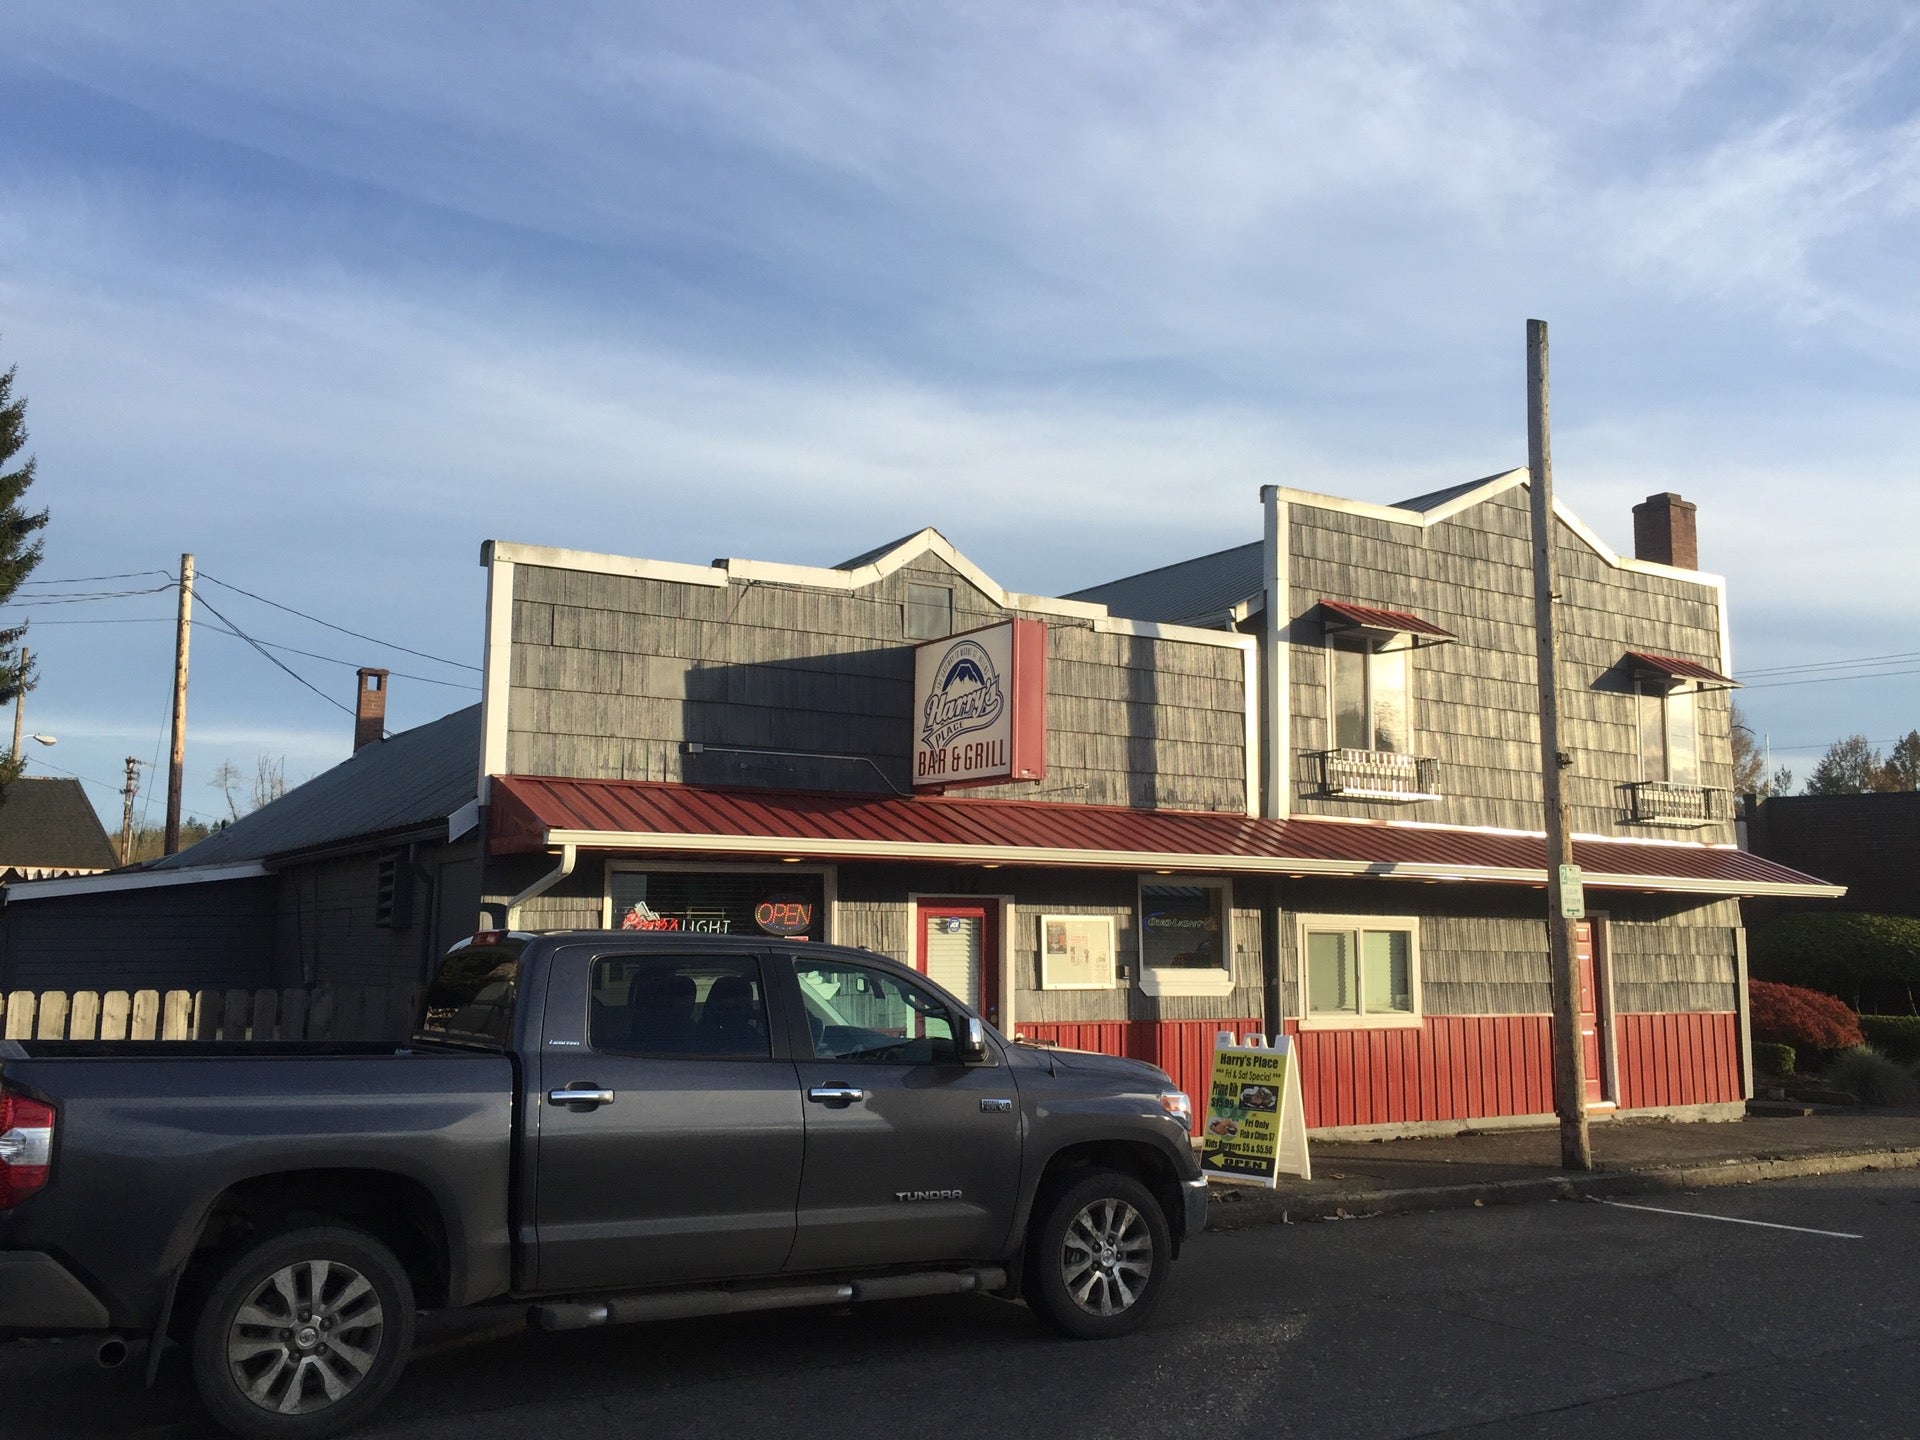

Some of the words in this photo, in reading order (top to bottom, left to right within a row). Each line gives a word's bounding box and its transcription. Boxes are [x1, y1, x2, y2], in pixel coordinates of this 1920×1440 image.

[925, 674, 1000, 728] Harry's
[935, 721, 964, 748] PLACE
[918, 748, 947, 776] BAR
[951, 746, 961, 772] &
[964, 739, 1006, 771] GRILL
[757, 903, 812, 925] OPEN
[1220, 1053, 1251, 1067] Harry's
[1253, 1056, 1279, 1069] Place
[1233, 1070, 1237, 1079] &
[1238, 1070, 1248, 1080] Sat
[1249, 1071, 1271, 1082] Special
[1212, 1081, 1228, 1096] Prime
[1245, 1119, 1254, 1127] Fri
[1255, 1120, 1270, 1130] Only
[1205, 1138, 1218, 1149] Kids
[1219, 1140, 1241, 1153] urgers
[1243, 1143, 1250, 1153] $5
[1256, 1144, 1273, 1155] $5.50
[1224, 1158, 1263, 1168] OPEN
[895, 1189, 963, 1201] TUNDRA
